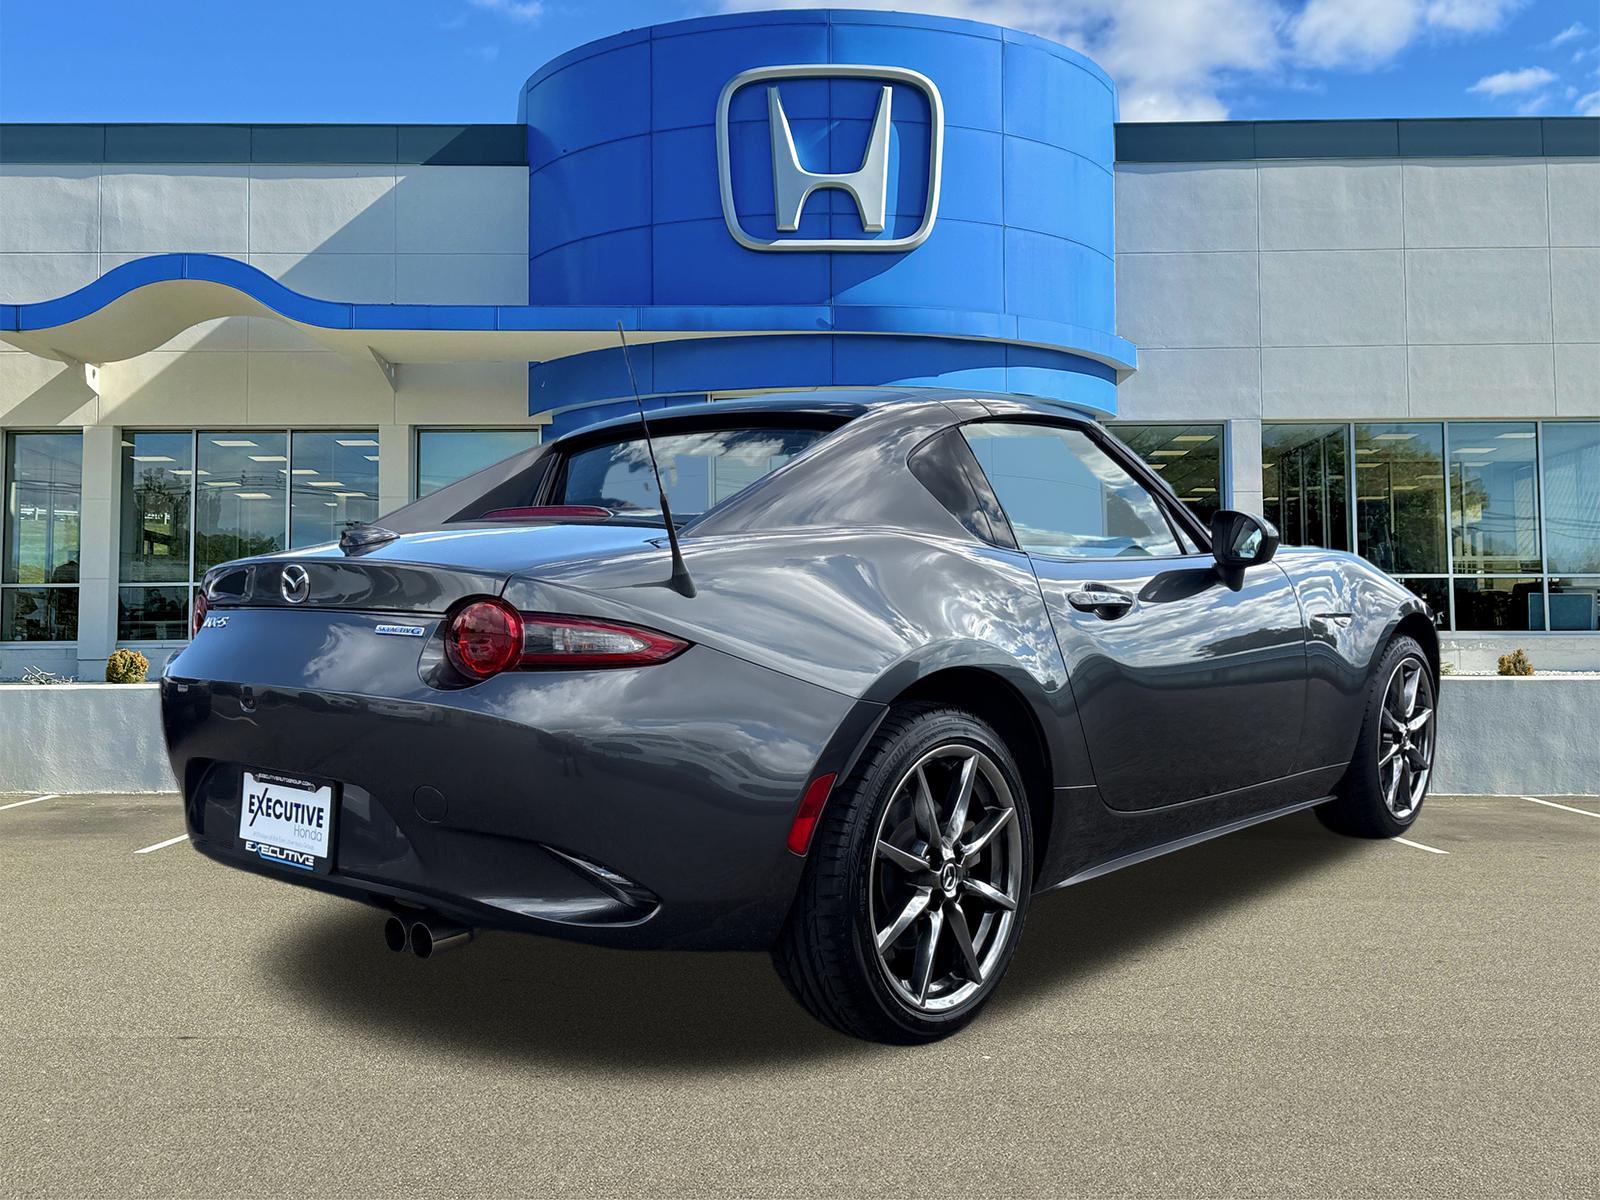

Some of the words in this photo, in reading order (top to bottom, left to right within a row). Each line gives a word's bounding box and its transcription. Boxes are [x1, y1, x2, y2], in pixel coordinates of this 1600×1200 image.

[249, 787, 324, 829] EXECUTIVE
[294, 825, 322, 842] Honda
[245, 840, 315, 866] EXECUTIVE
